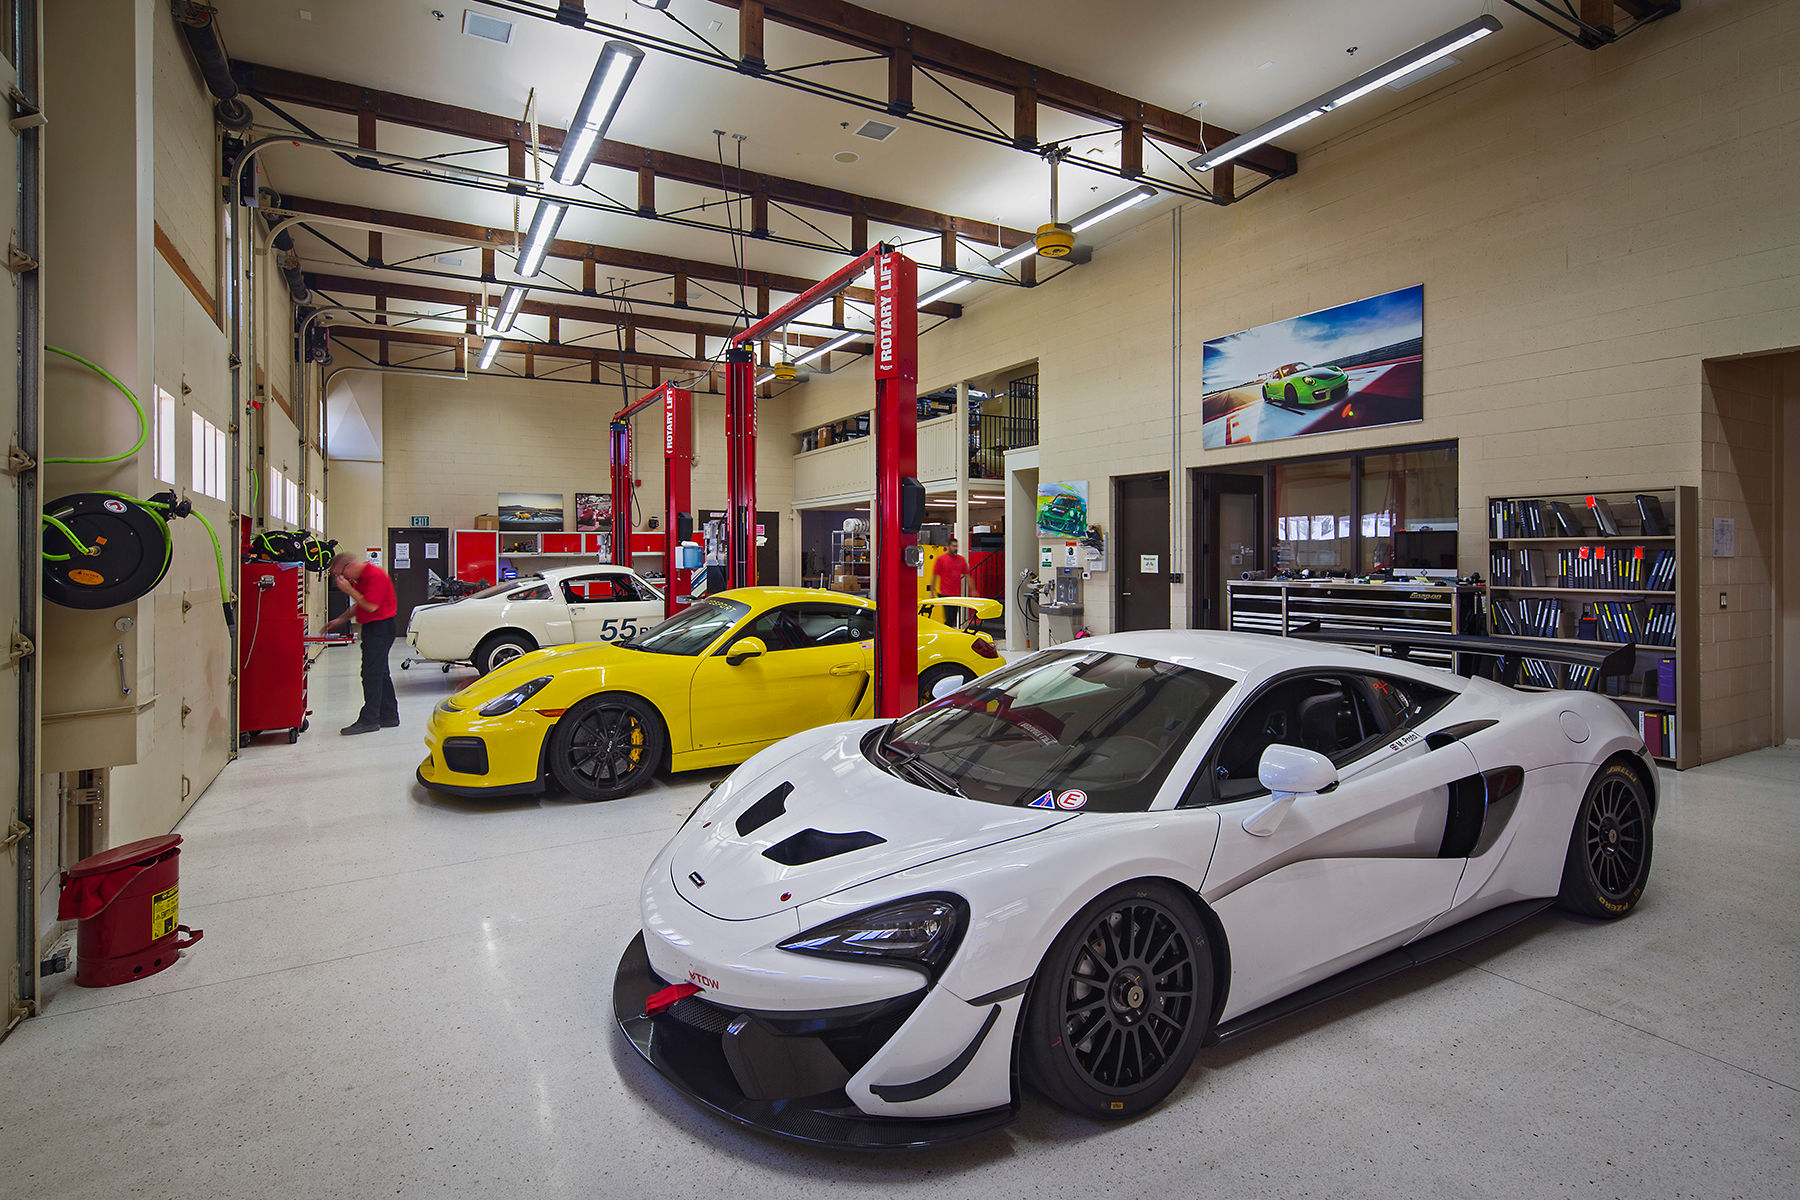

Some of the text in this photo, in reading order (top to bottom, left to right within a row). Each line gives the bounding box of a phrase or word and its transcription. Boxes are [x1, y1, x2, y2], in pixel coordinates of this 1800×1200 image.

[880, 256, 892, 291] LIFT
[880, 296, 892, 362] ROTARY
[413, 517, 428, 526] EXIT
[600, 618, 638, 642] 55
[1064, 793, 1080, 806] E
[695, 972, 719, 990] TOW
